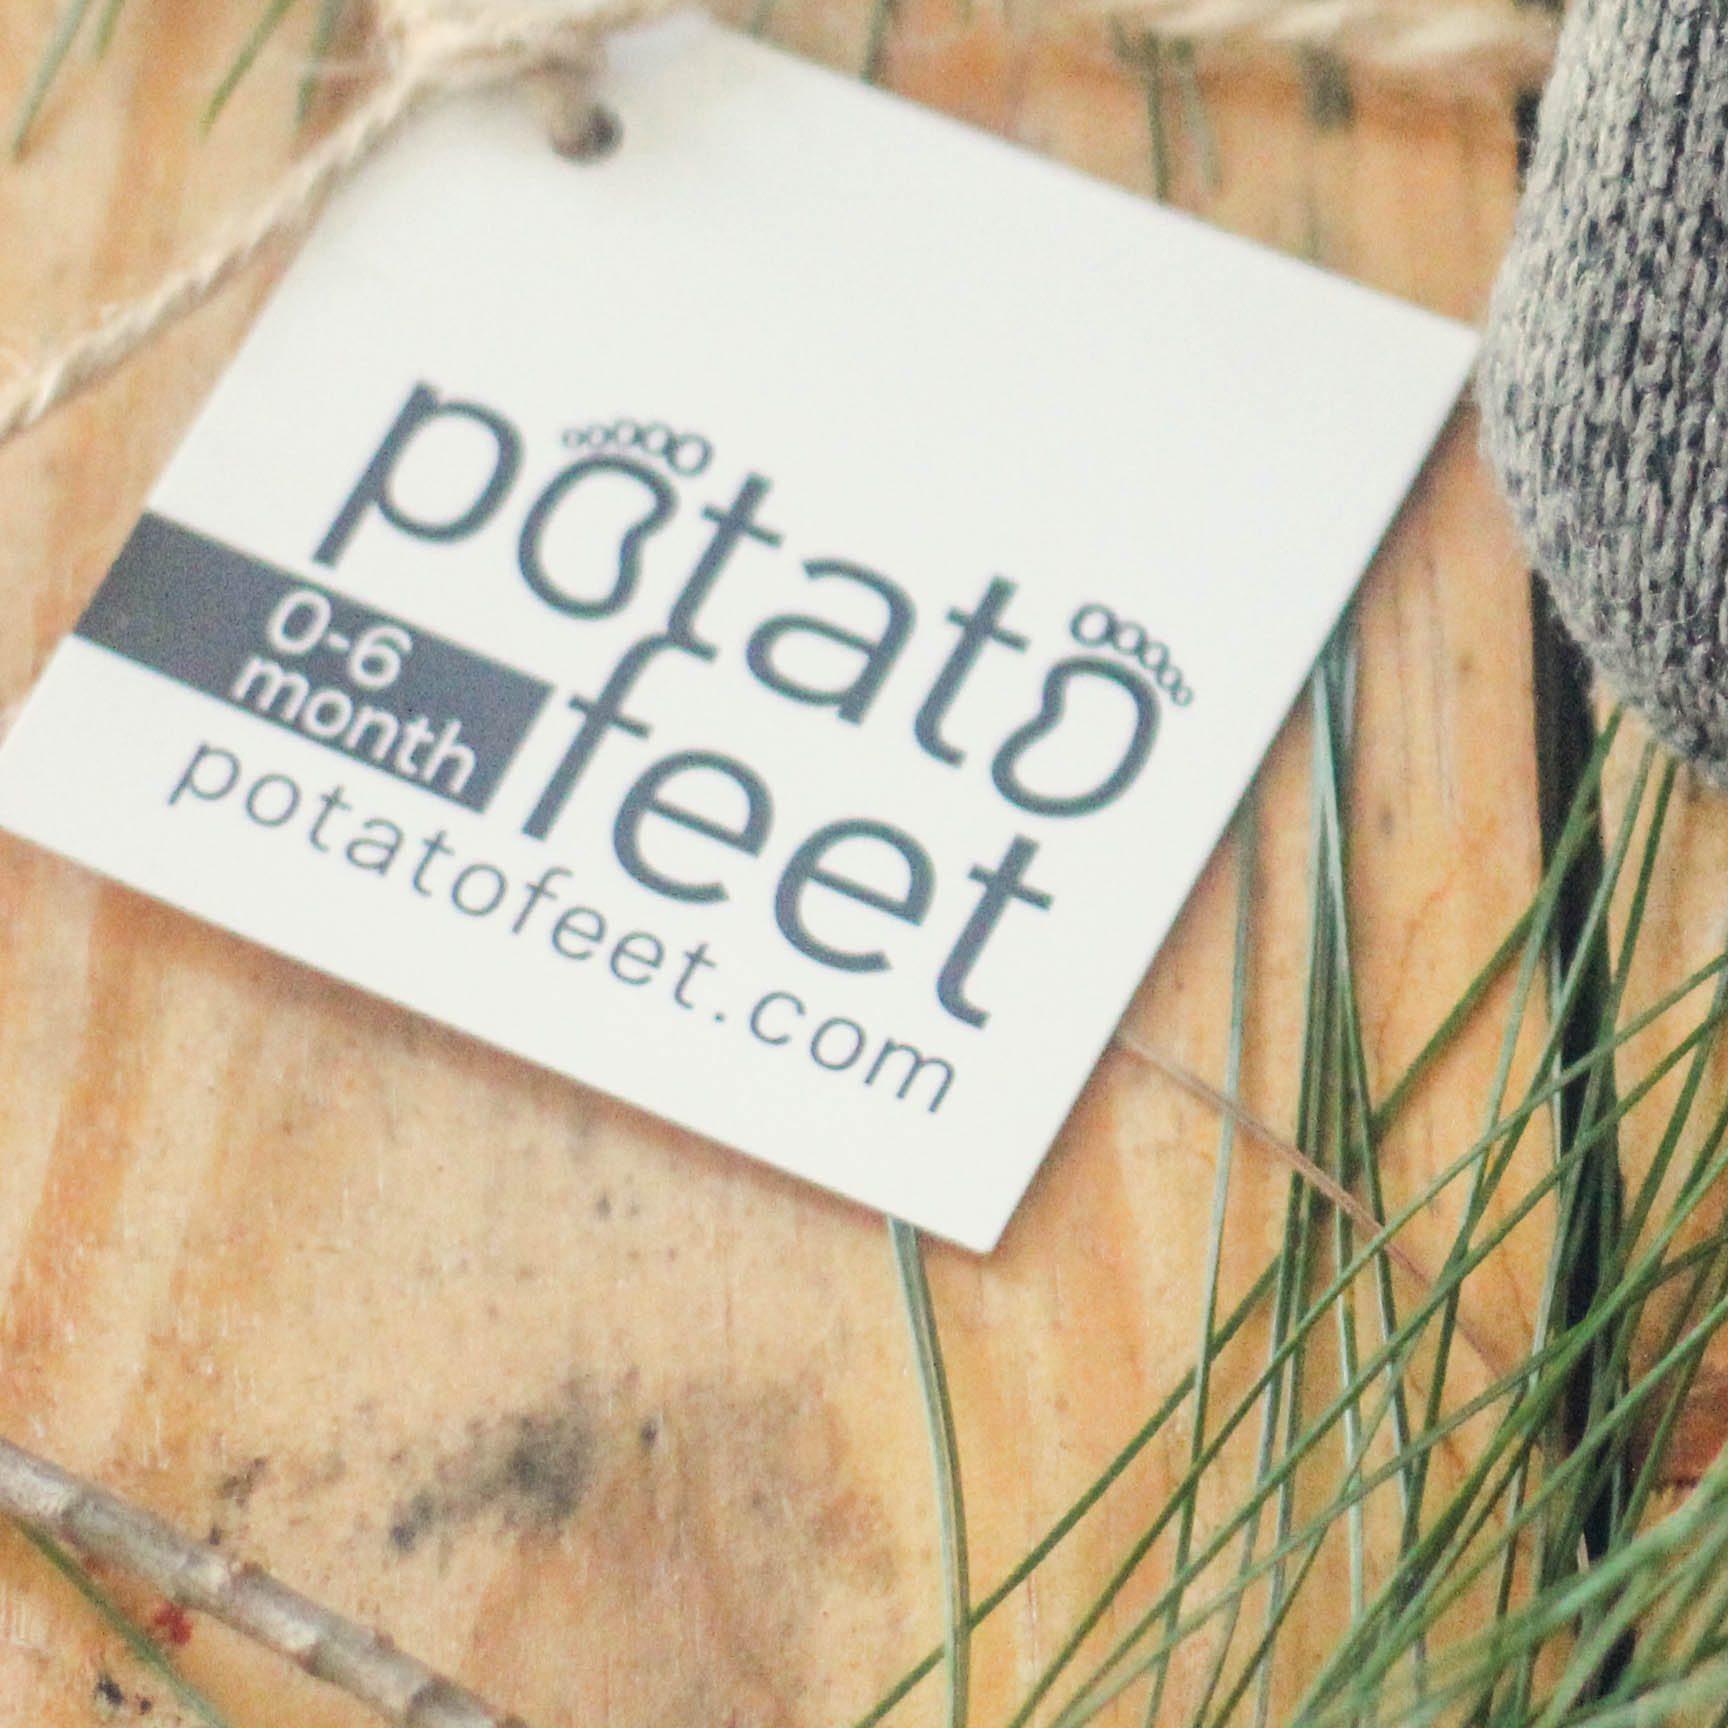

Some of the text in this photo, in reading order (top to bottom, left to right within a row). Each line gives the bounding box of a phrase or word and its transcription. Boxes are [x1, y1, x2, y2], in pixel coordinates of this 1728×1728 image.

[231, 655, 478, 793] month
[267, 588, 413, 688] 0-6
[312, 382, 1180, 818] potato
[167, 742, 959, 1115] potatofeet.com
[520, 630, 1055, 1032] feet
